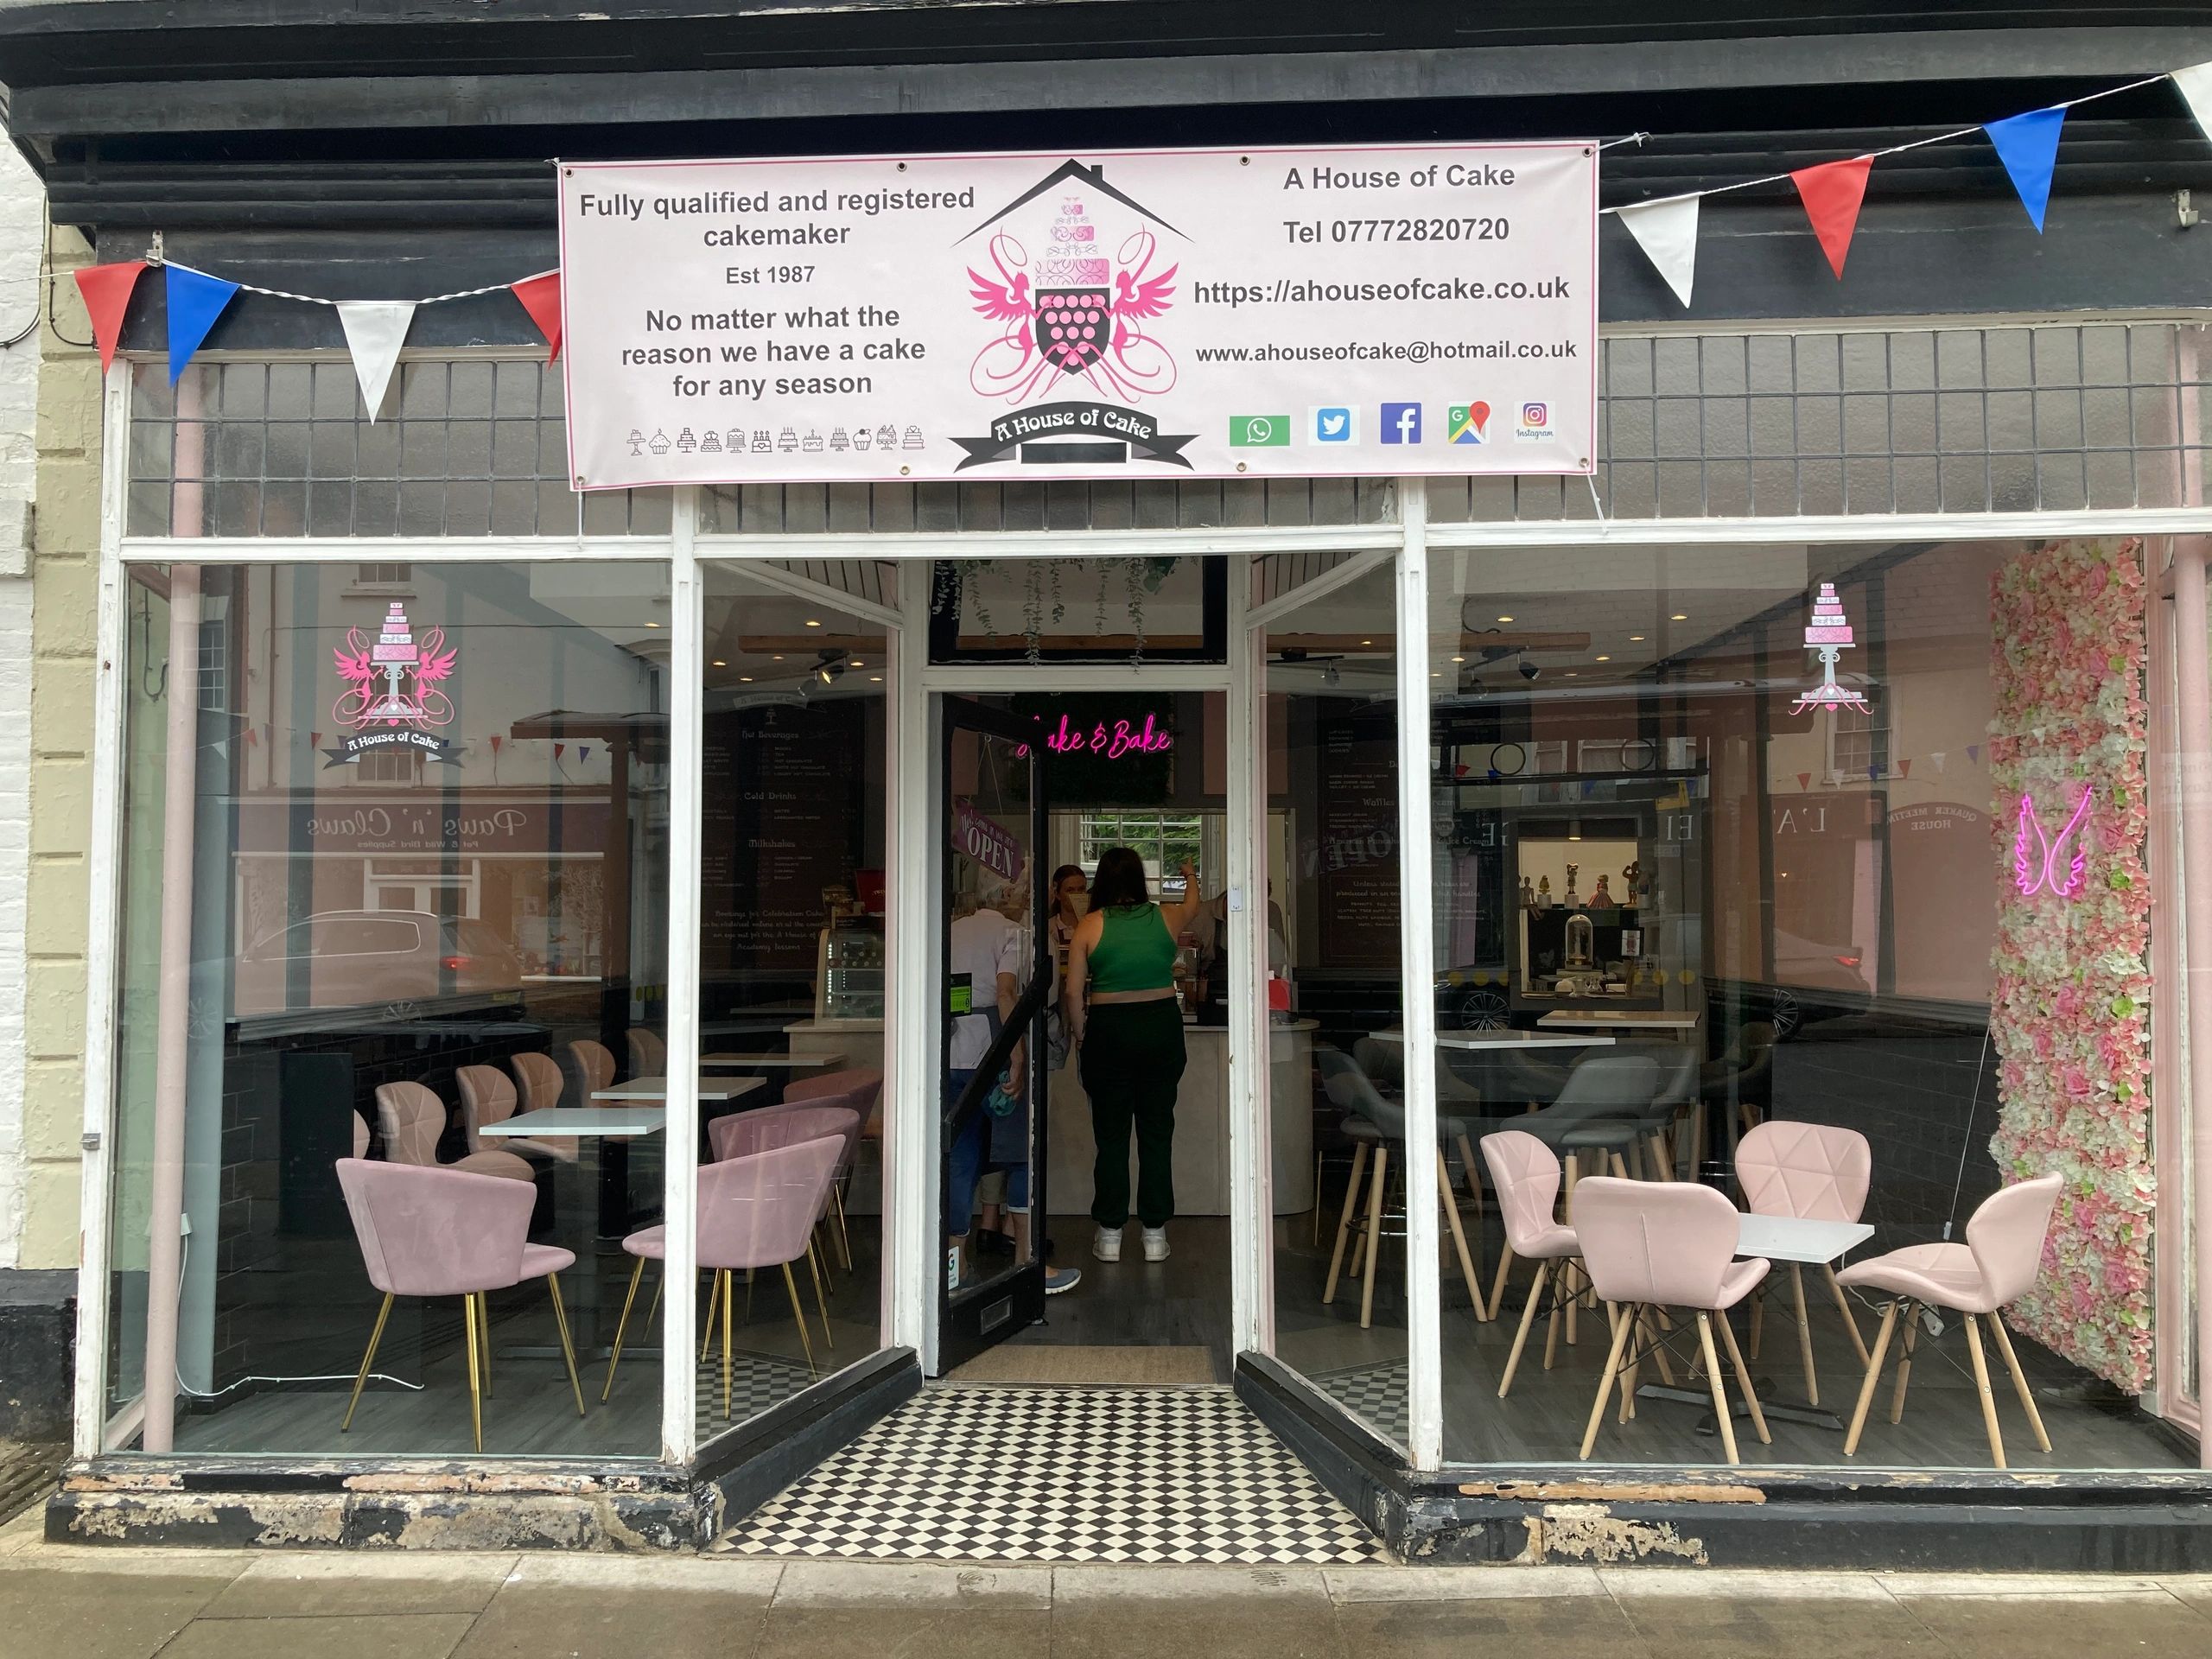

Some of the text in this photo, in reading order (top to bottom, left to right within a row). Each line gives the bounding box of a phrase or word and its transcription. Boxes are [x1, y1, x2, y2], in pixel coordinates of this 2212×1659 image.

[1283, 164, 1515, 190] A House of Cake
[580, 186, 974, 221] Fully qualified and registered
[703, 222, 851, 247] cakemaker
[1282, 218, 1510, 244] Tel 07772820720
[726, 265, 816, 284] Est 1987
[1194, 276, 1570, 308] https://ahouseofcake.co.uk
[646, 305, 899, 332] No matter what the
[622, 338, 925, 365] reason we have a cake
[1195, 340, 1577, 364] www.ahouseofcake@hotmail.co.uk
[672, 375, 872, 401] for any season
[995, 409, 1152, 442] A House of Cake
[1516, 429, 1554, 439] Instagram
[347, 732, 440, 751] A House of Cake
[1090, 721, 1107, 754] &
[1108, 715, 1172, 759] Bake
[744, 791, 797, 801] Cold Drinks
[1362, 798, 1395, 806] Waffles
[968, 827, 1014, 878] OPEN
